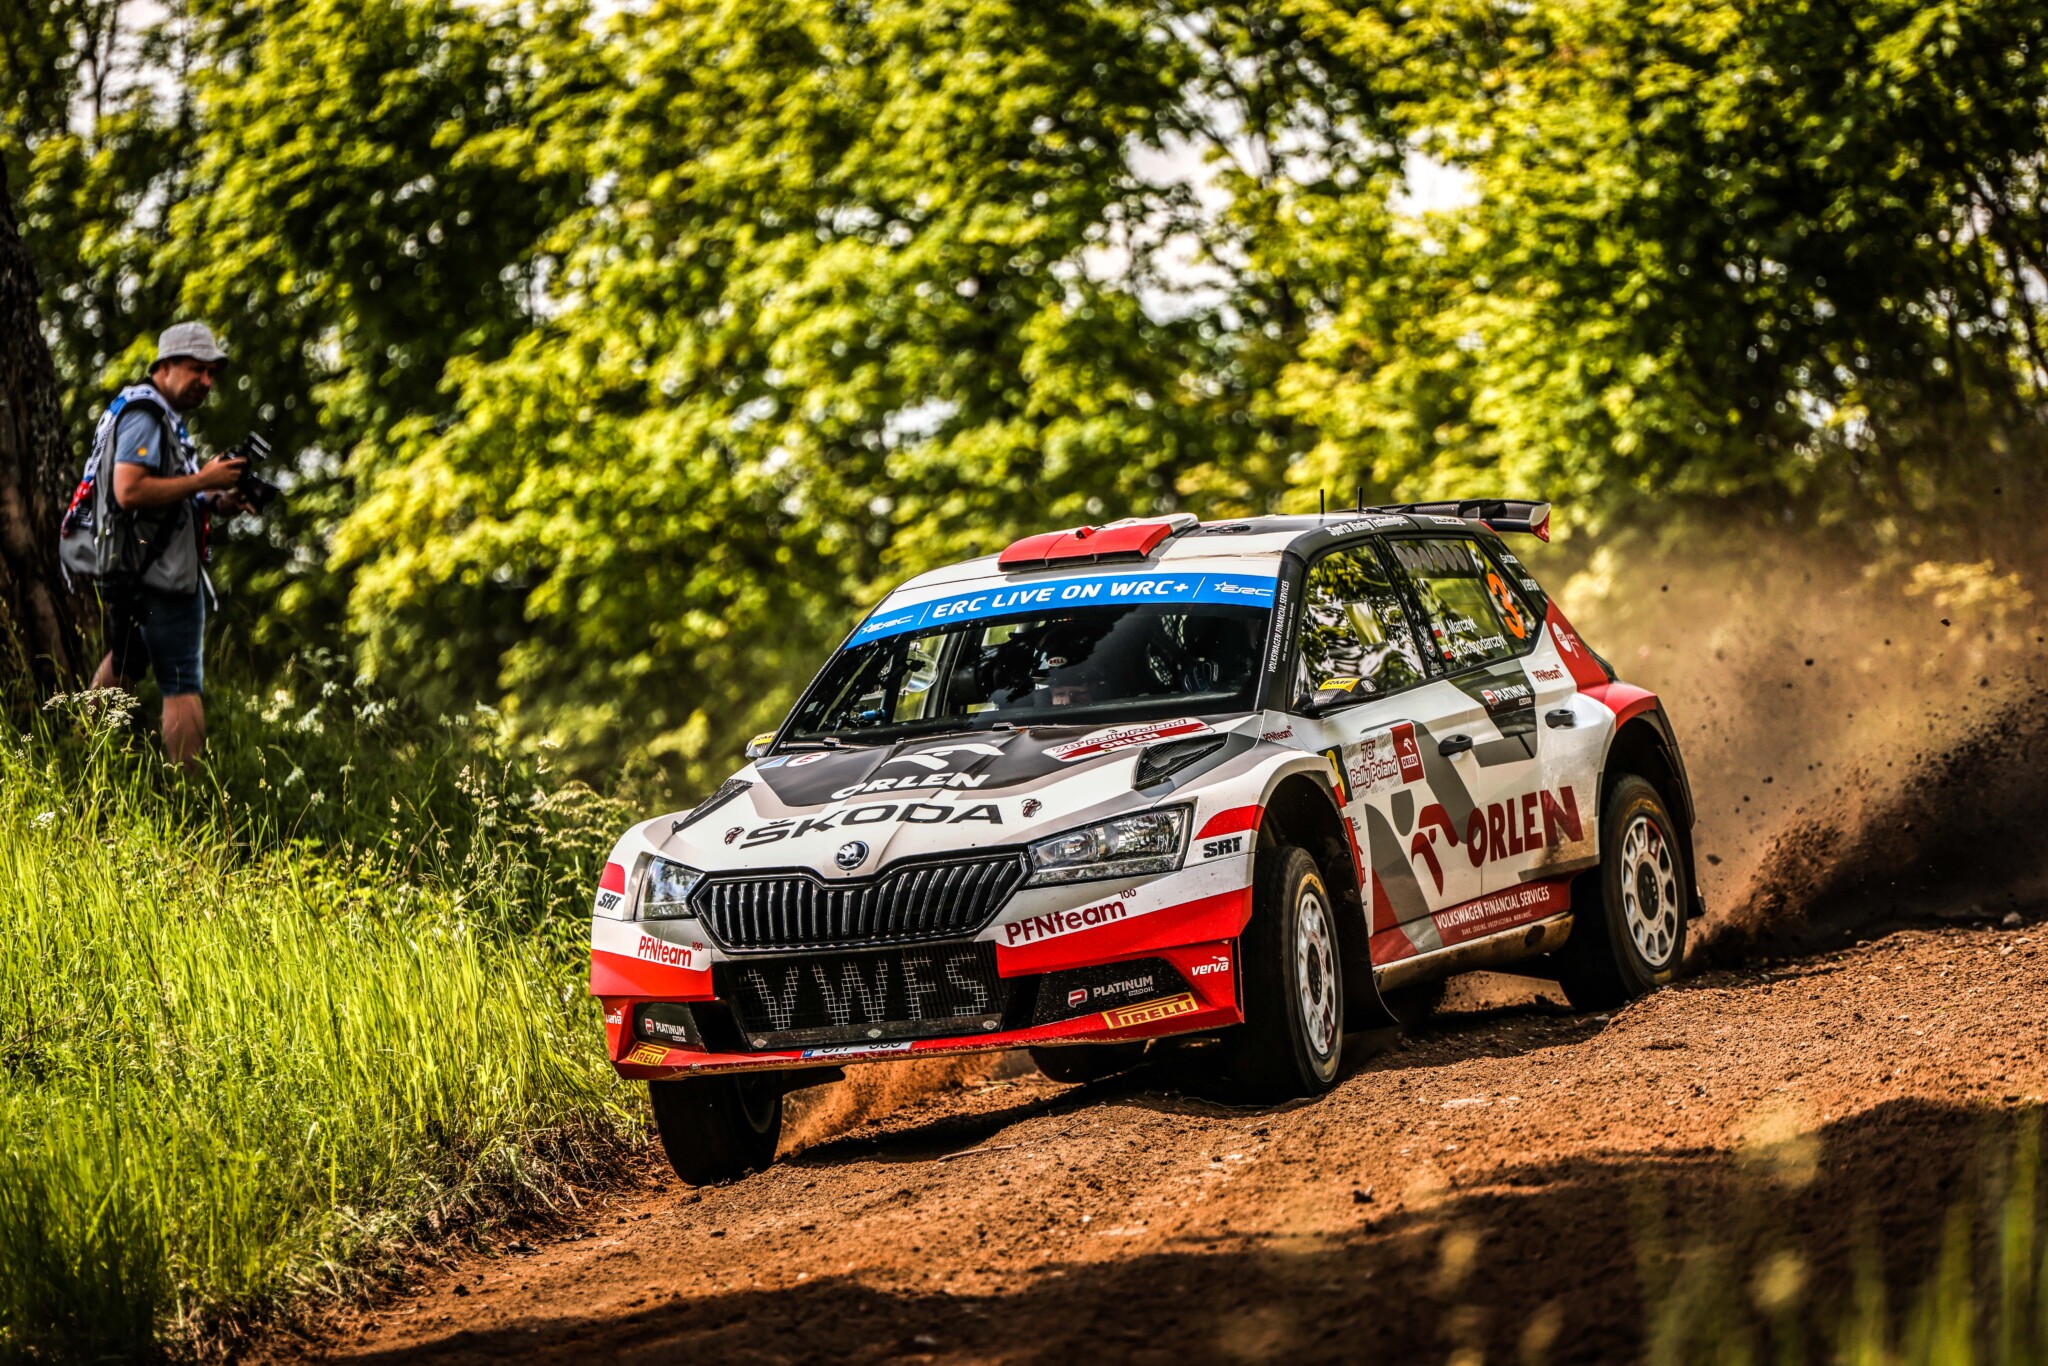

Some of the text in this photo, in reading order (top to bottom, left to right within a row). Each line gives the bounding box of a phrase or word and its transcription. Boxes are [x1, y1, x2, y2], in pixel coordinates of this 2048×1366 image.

[932, 580, 1190, 619] ERC LIVE ON WRC+
[1280, 580, 1290, 605] SERVICES
[1488, 573, 1526, 639] 3
[1275, 604, 1286, 635] FINANCIAL
[1268, 634, 1282, 673] VOLKSWAGEN
[1493, 684, 1531, 701] PLATINUM
[1099, 733, 1161, 749] ORLEN
[831, 773, 991, 801] ORLEN
[1349, 755, 1399, 790] Rally Poland
[739, 802, 1003, 849] ŠKODA
[1466, 785, 1583, 868] ORLEN
[1203, 836, 1242, 859] SRT
[597, 892, 622, 911] SRT
[1435, 886, 1550, 930] VOLKSWAGEN FINANCIAL SERVICES
[1005, 901, 1127, 945] PFNteam
[637, 935, 692, 967] PFNteam
[1191, 961, 1229, 976] verva
[747, 952, 989, 1031] VWFS
[1093, 975, 1153, 998] PLATINUM
[1105, 993, 1195, 1027] PIRELLI
[655, 1021, 686, 1036] PLATINUM
[629, 1041, 668, 1065] PIRELLI
